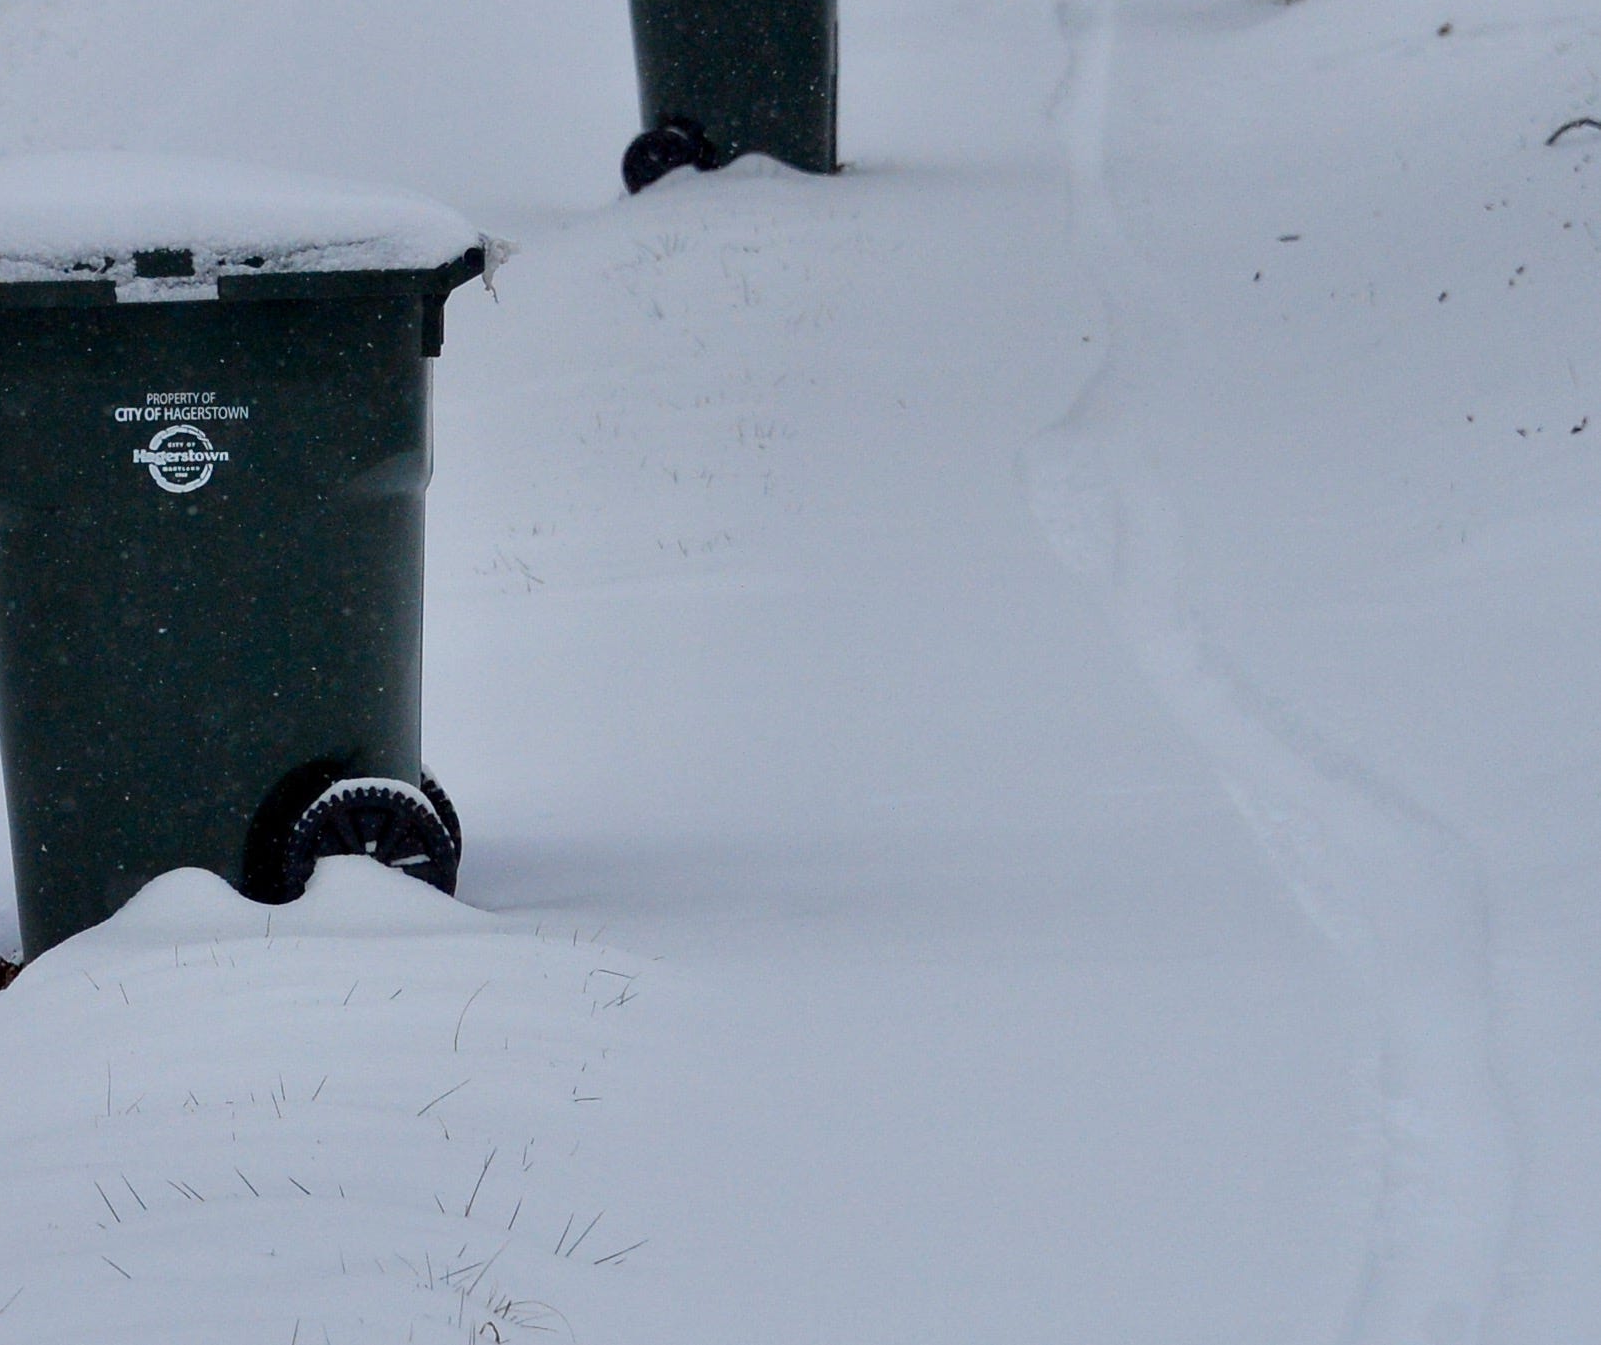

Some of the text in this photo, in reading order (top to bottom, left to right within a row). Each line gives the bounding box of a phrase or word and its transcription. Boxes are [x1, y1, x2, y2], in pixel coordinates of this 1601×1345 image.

[147, 393, 215, 404] PROPERTY OF
[115, 406, 248, 421] CITY OF HAGERSTOWN
[133, 449, 228, 465] Hagerstown
